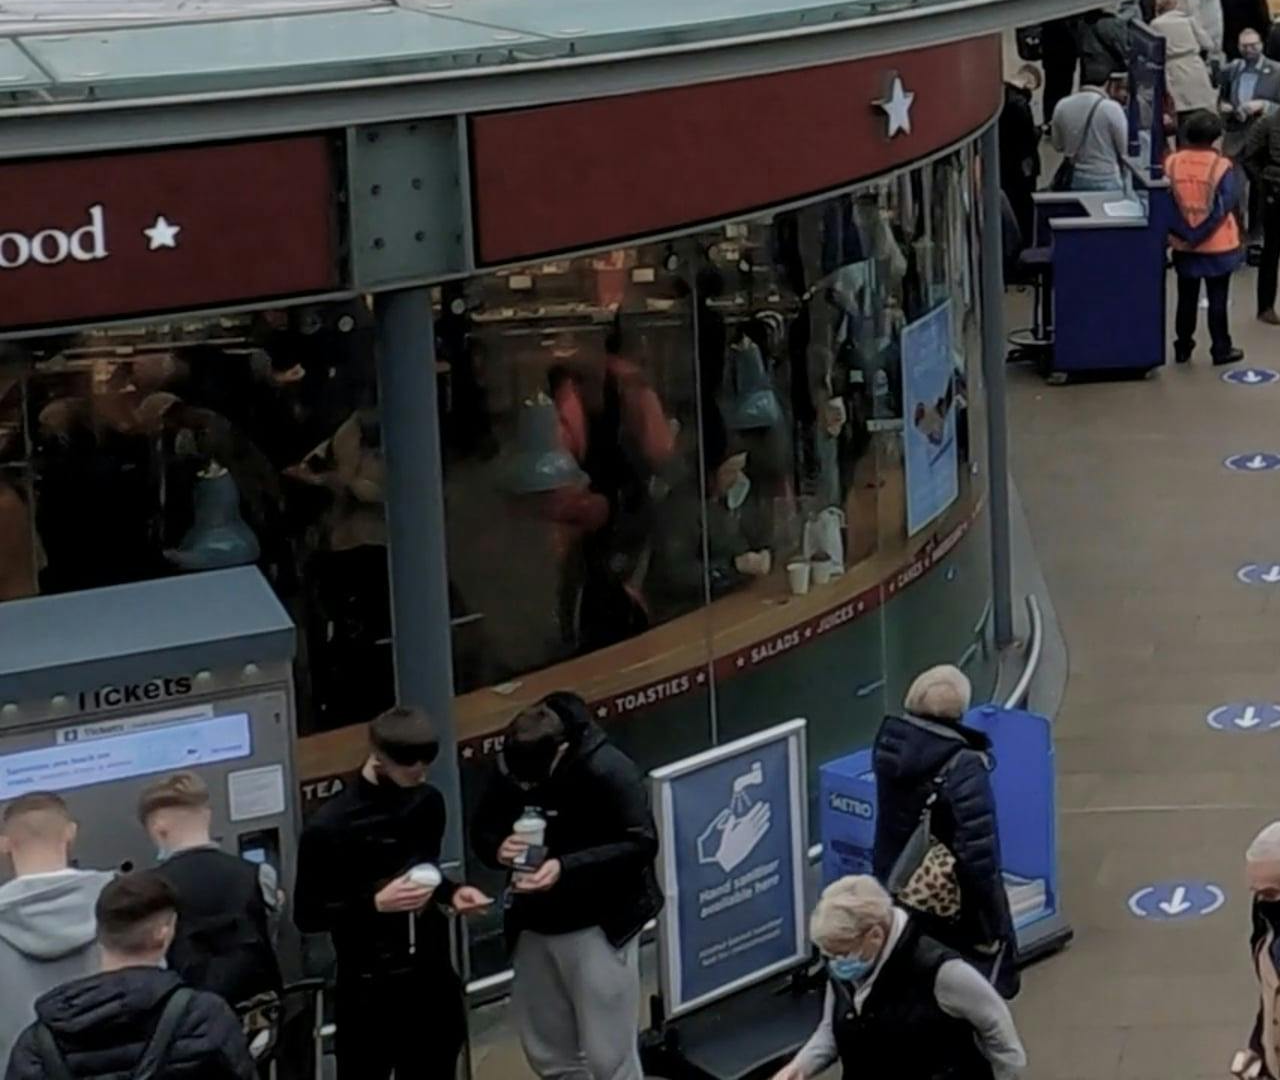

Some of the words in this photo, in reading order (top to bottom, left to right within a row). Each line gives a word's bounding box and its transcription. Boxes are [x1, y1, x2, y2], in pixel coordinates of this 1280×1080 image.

[0, 204, 108, 268] ood
[816, 603, 854, 634] JUICES
[750, 631, 800, 664] SALADS
[616, 676, 690, 714] TOASTIES
[831, 794, 873, 819] METRO
[700, 878, 732, 903] Hand
[700, 888, 753, 918] available
[754, 874, 780, 894] here
